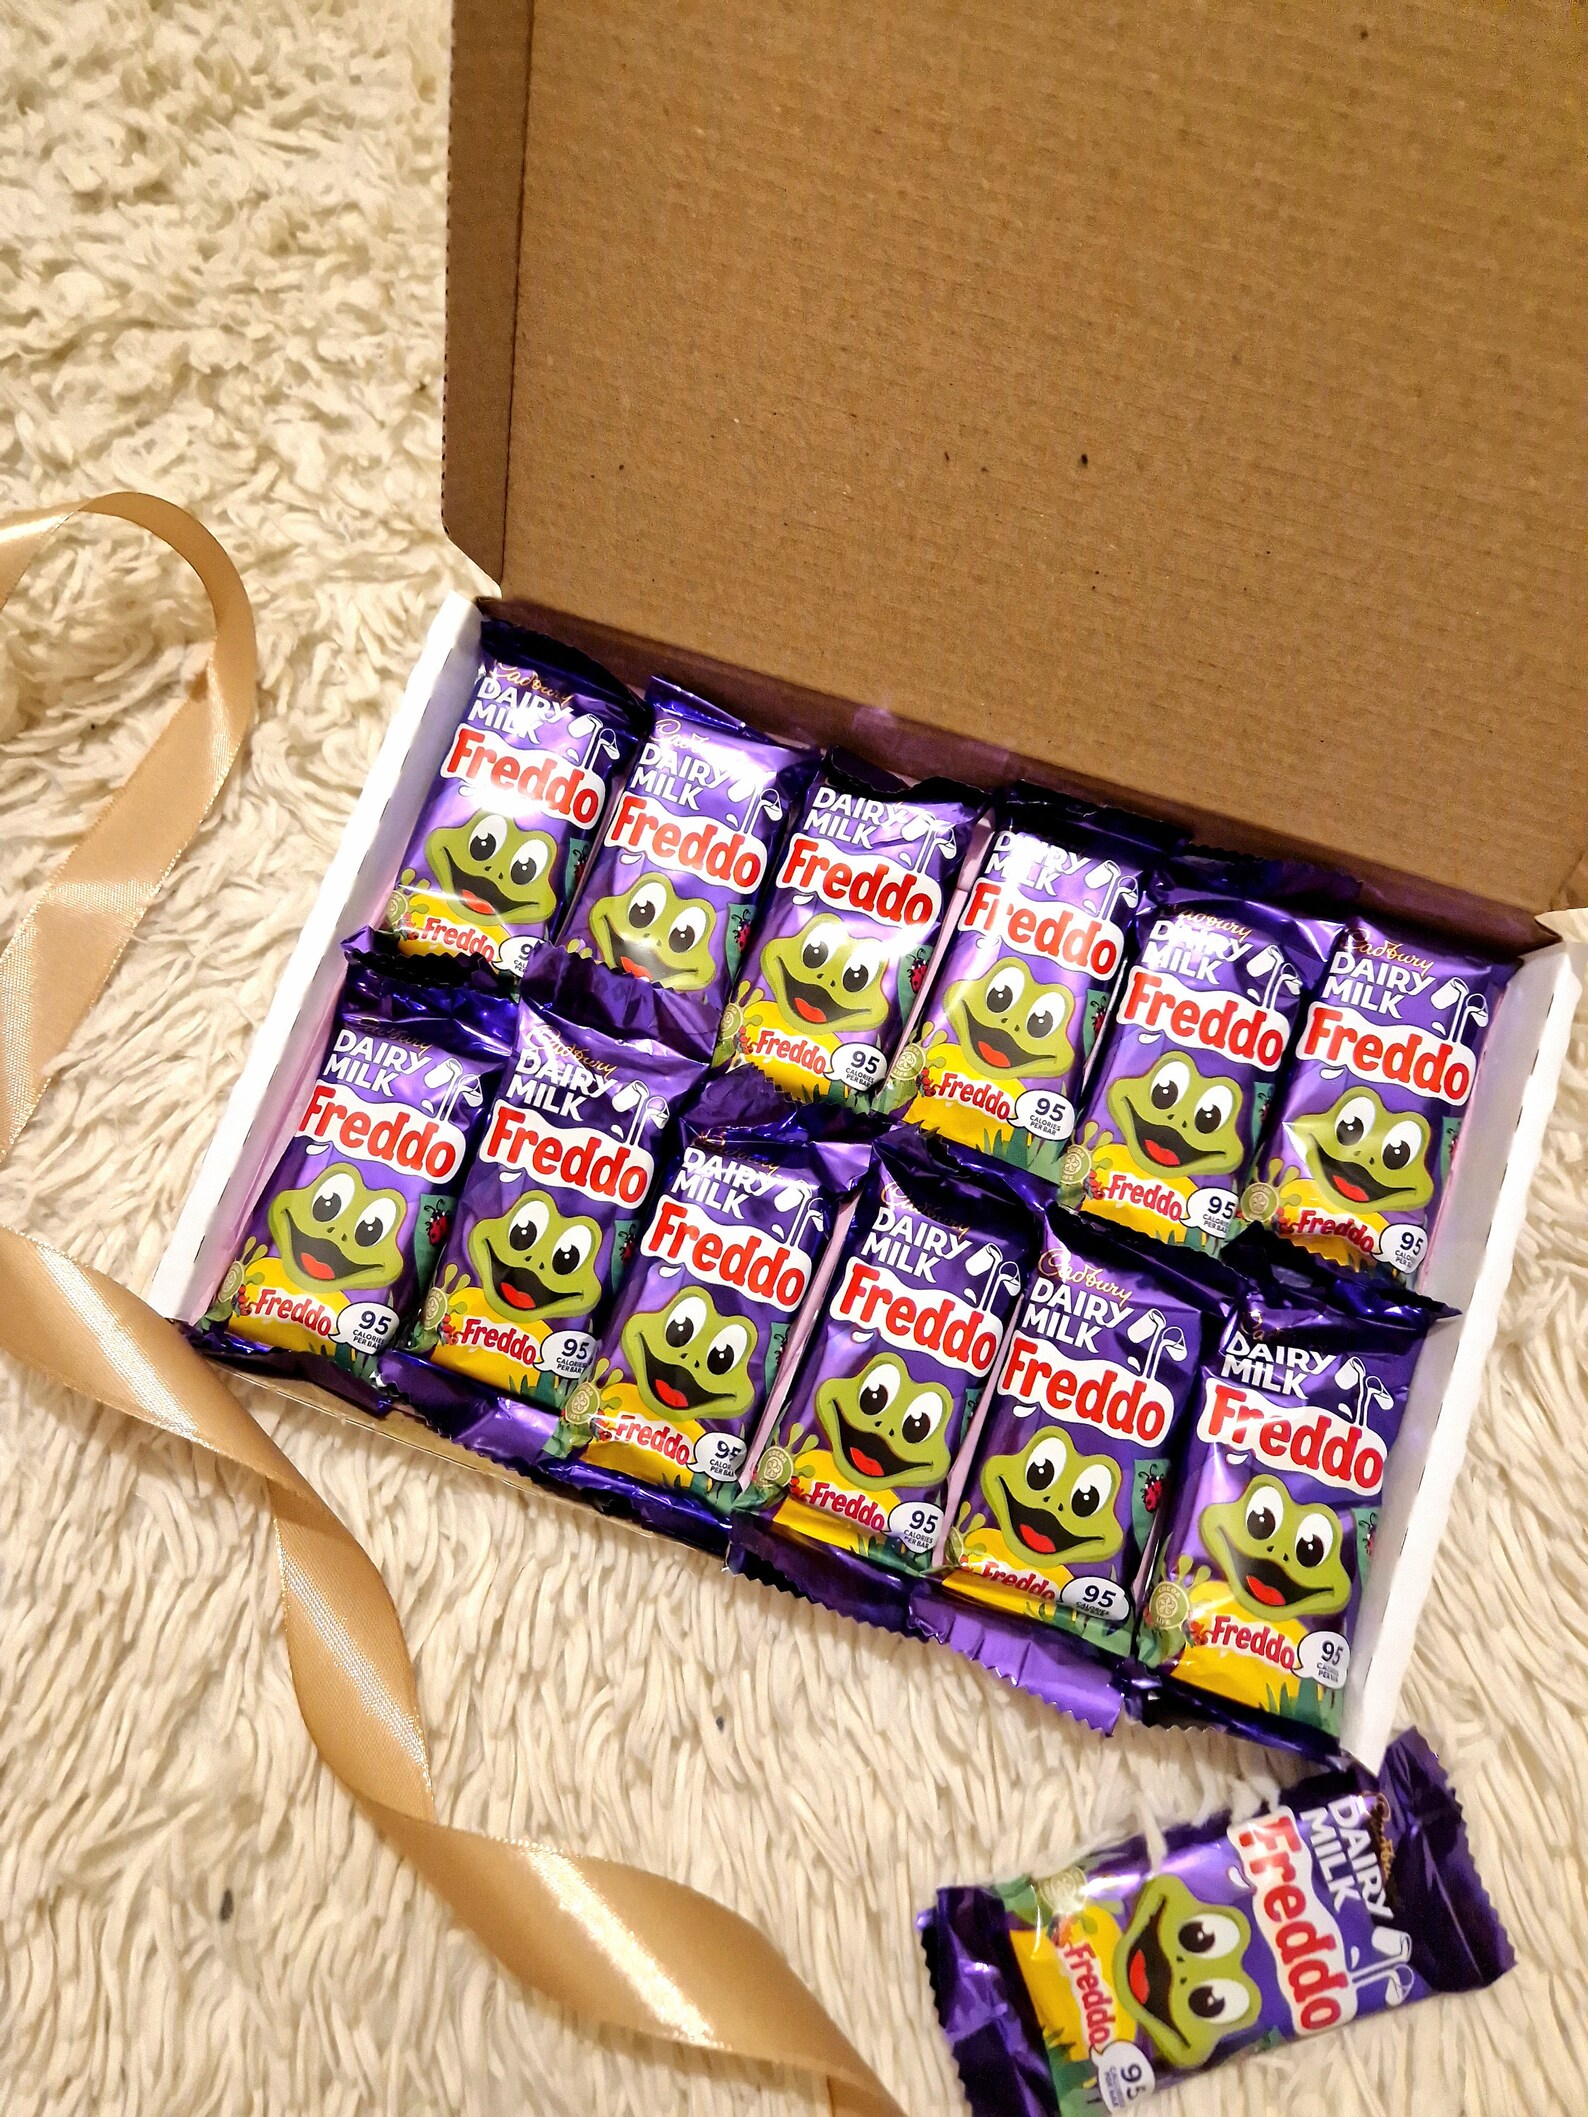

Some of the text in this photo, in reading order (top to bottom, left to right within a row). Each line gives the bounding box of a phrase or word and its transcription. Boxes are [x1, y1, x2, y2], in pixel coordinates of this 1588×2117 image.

[477, 677, 574, 722] DAIRY
[468, 702, 541, 745] MILK
[447, 728, 599, 824] Freddo
[639, 742, 728, 787] DAIRY
[630, 766, 704, 811] MILK
[813, 786, 907, 830] DAIRY
[611, 795, 760, 888] Freddo
[804, 810, 878, 850] MILK
[782, 839, 933, 926] Freddo
[421, 917, 495, 963] Freddo
[964, 882, 1117, 974] Freddo
[1344, 927, 1434, 974] Cadbury
[518, 943, 533, 961] 9
[1141, 940, 1223, 985] MILK
[1331, 951, 1436, 996] DAIRY
[1124, 972, 1283, 1066] Freddo
[1322, 976, 1406, 1019] MILK
[333, 1029, 431, 1075] DAIRY
[516, 1049, 617, 1098] DAIRY
[527, 1025, 617, 1078] Cadbury
[757, 1027, 826, 1075] Freddo
[850, 1050, 880, 1074] 95
[1304, 1006, 1469, 1100] Freddo
[323, 1054, 399, 1097] MILK
[506, 1075, 587, 1122] MILK
[845, 1067, 874, 1084] CALORIES
[846, 1074, 859, 1084] PER
[939, 1073, 1010, 1120] Freddo
[299, 1084, 456, 1178] Freddo
[1029, 1114, 1061, 1132] CALORIES
[1030, 1121, 1057, 1136] PER BAR
[1034, 1097, 1066, 1122] 95
[487, 1108, 647, 1204] Freddo
[684, 1147, 783, 1198] DAIRY
[671, 1170, 748, 1219] MILK
[1108, 1175, 1182, 1221] Freddo
[1207, 1195, 1236, 1220] 95
[873, 1206, 972, 1261] DAIRY
[1204, 1220, 1216, 1230] PER
[1299, 1210, 1374, 1253] Freddo
[1400, 1231, 1424, 1256] 95
[648, 1201, 806, 1303] Freddo
[861, 1237, 940, 1284] MILK
[1038, 1247, 1132, 1308] Cadbury
[257, 1289, 331, 1337] Freddo
[358, 1310, 392, 1335] 95
[839, 1265, 998, 1371] Freddo
[1031, 1275, 1134, 1328] DAIRY
[353, 1336, 366, 1346] PER
[461, 1319, 536, 1365] Freddo
[562, 1338, 589, 1361] 95
[1022, 1303, 1102, 1353] MILK
[556, 1363, 569, 1372] PER
[1226, 1331, 1337, 1374] DAIRY
[1002, 1338, 1164, 1440] Freddo
[1220, 1355, 1308, 1399] MILK
[616, 1414, 689, 1465] Freddo
[715, 1439, 741, 1462] 95
[1208, 1385, 1383, 1489] Freddo
[710, 1465, 722, 1475] PER
[809, 1482, 885, 1532] Freddo
[908, 1510, 939, 1534] 95
[903, 1529, 934, 1544] CALORIES
[916, 1540, 930, 1550] BAR
[983, 1562, 1056, 1599] Freddo
[1082, 1585, 1116, 1608] 95
[1212, 1616, 1295, 1669] Freddo
[1321, 1640, 1343, 1667] 95
[1299, 1807, 1361, 1912] MILK
[1328, 1795, 1394, 1919] DAIRY
[1238, 1814, 1349, 2032] Freddo
[1065, 1942, 1116, 2046] Freddo
[1120, 2064, 1146, 2101] 95
